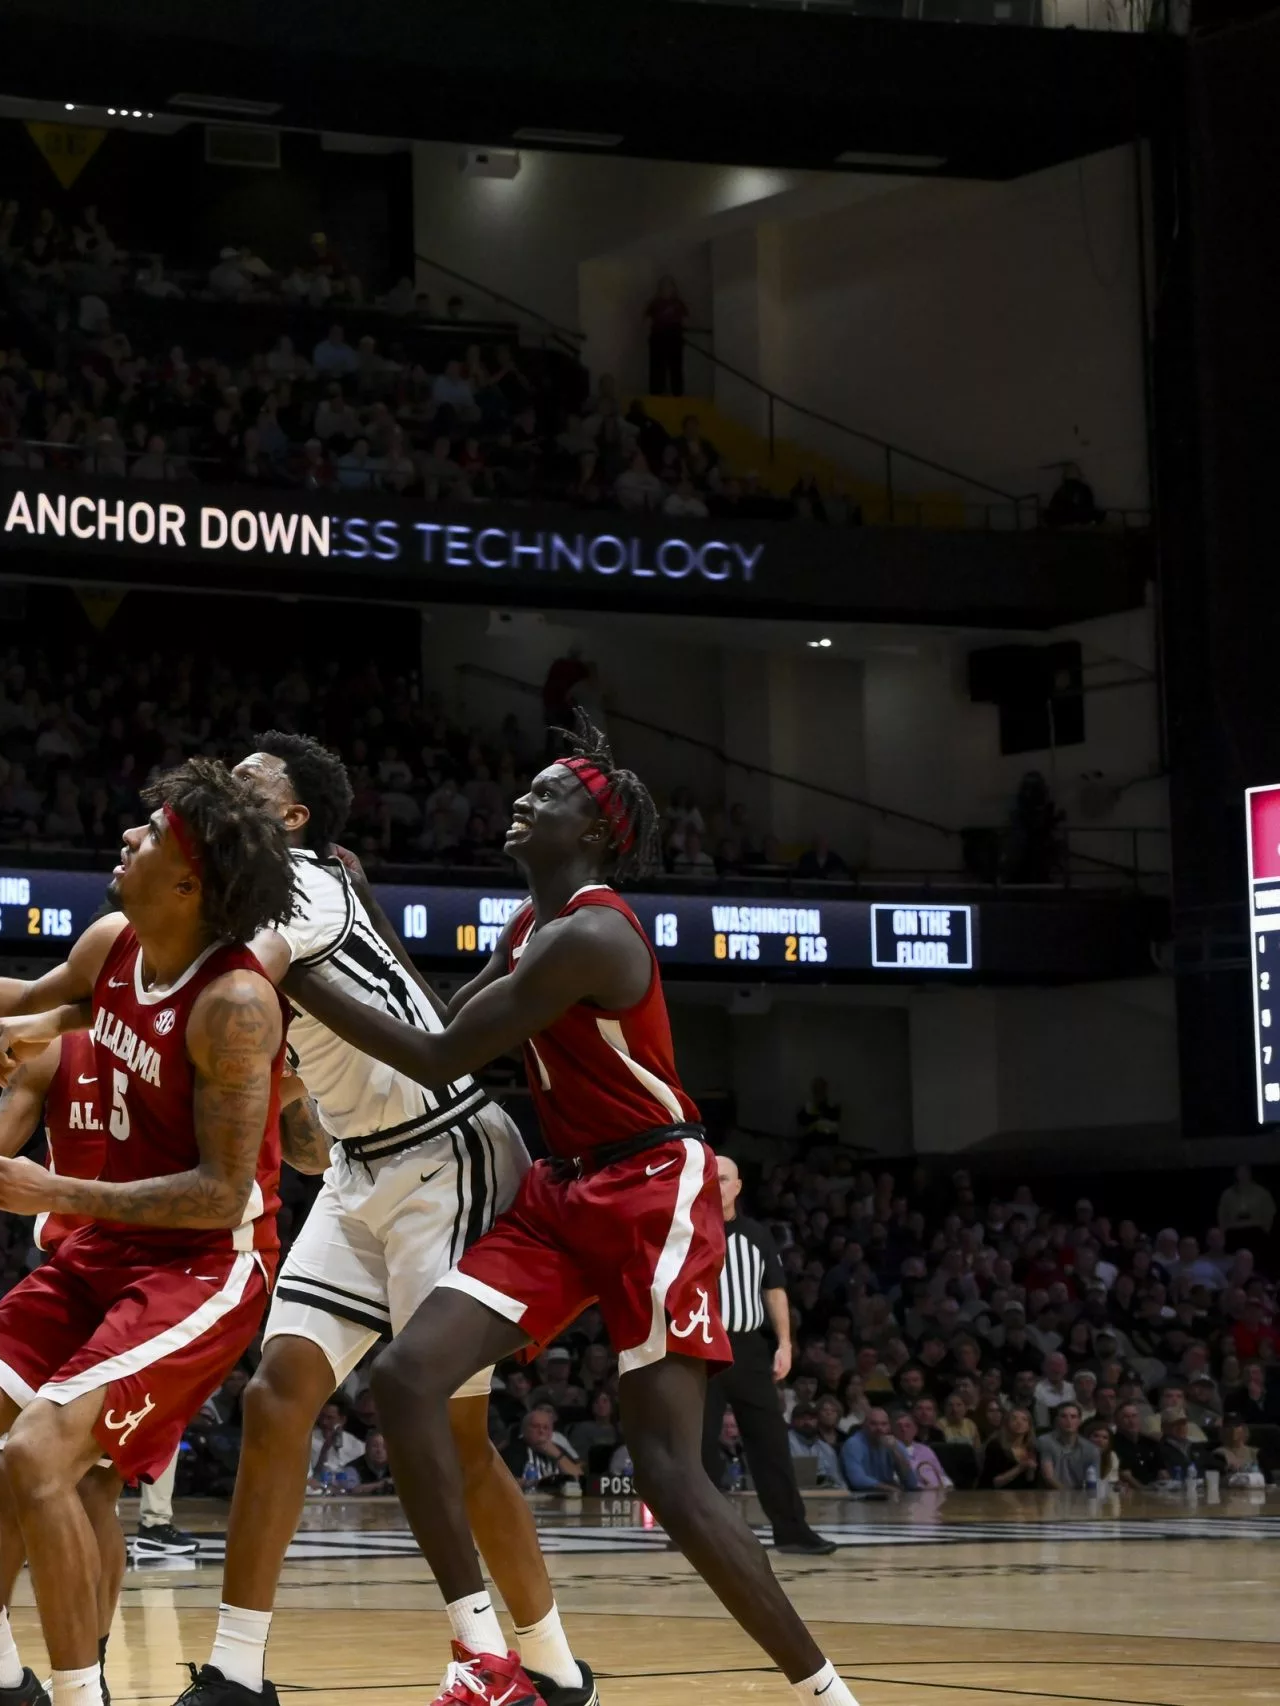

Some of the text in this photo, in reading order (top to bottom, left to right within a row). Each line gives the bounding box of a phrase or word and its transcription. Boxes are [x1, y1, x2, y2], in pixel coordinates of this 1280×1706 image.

[4, 491, 330, 557] ANCHOR DOWN
[331, 516, 764, 582] SS TECHNOLOGY
[28, 908, 41, 935] 2
[42, 909, 72, 937] FLS
[403, 904, 427, 938] 10
[655, 913, 678, 947] 13
[712, 905, 820, 935] WASHINGTON
[892, 910, 951, 936] ON THE
[456, 925, 504, 951] 10 PT
[714, 933, 827, 962] 6 PTS 2 FLS
[896, 942, 949, 966] FLOOR
[93, 1007, 161, 1088] ALABAMA
[69, 1101, 104, 1130] AL
[109, 1068, 131, 1141] 5
[600, 1476, 637, 1495] POS
